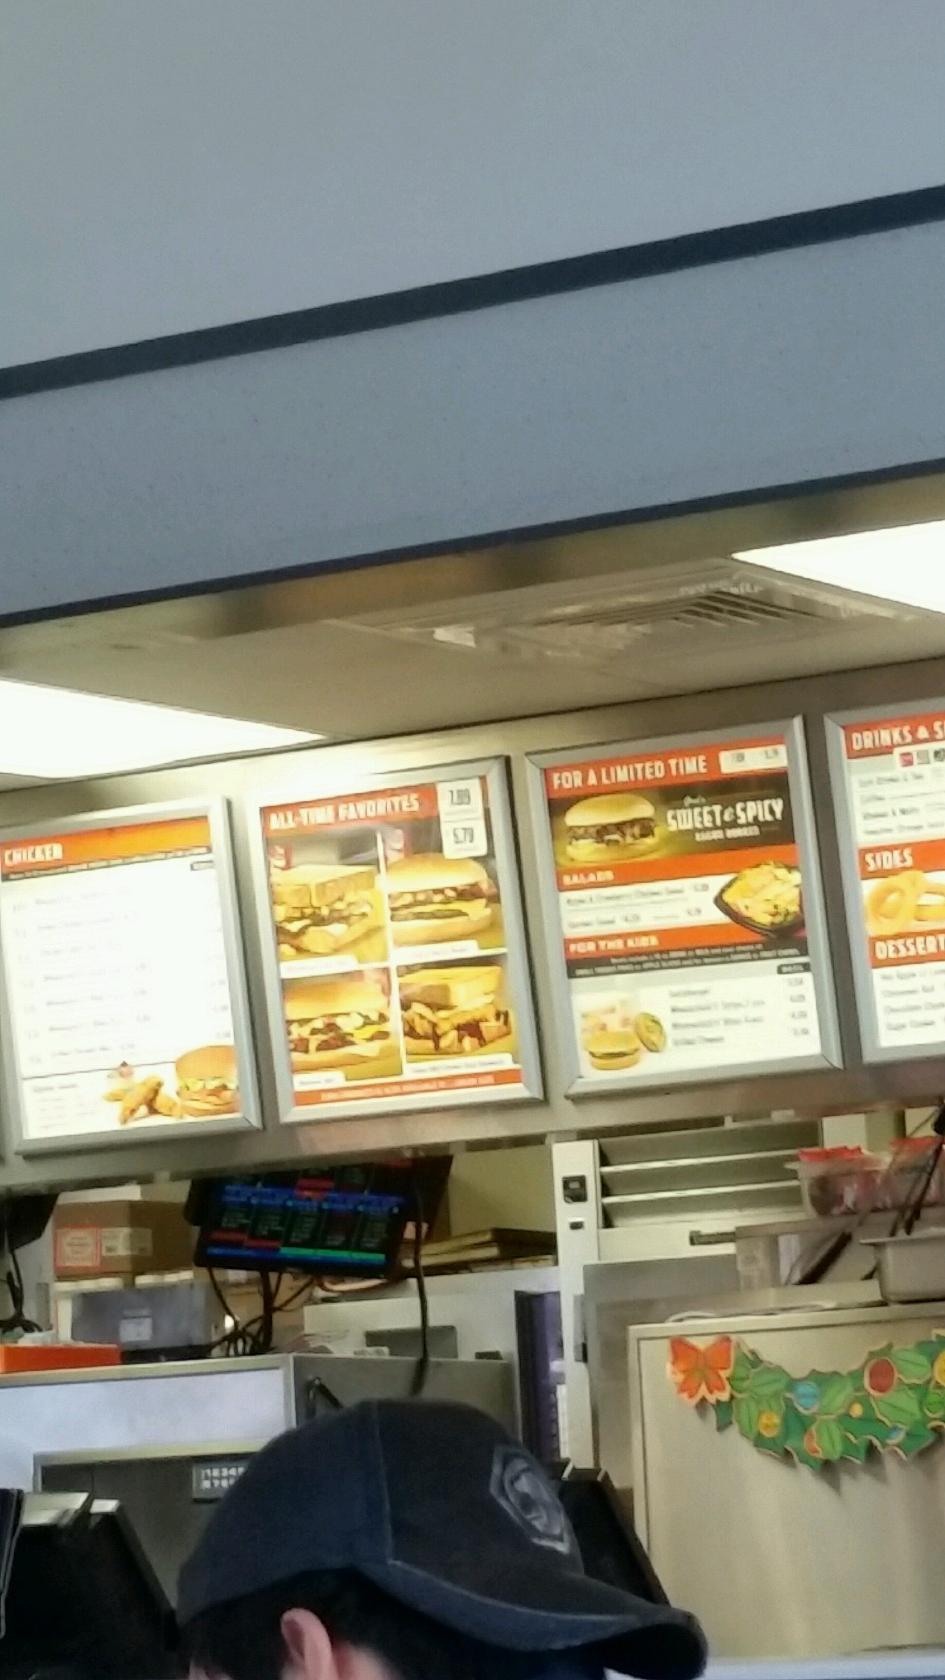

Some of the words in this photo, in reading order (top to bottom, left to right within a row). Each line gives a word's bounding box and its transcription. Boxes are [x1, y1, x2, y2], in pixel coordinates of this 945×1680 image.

[852, 726, 912, 750] DRINKS
[933, 720, 945, 740] S
[552, 770, 583, 789] FOR
[587, 769, 598, 786] A
[601, 760, 666, 784] LIMITED
[668, 755, 708, 776] TIME
[339, 793, 420, 820] FAVORITES
[667, 804, 722, 832] SWEET
[736, 798, 784, 824] SPICY
[4, 843, 64, 866] CHICKEN
[865, 848, 913, 872] SIDES
